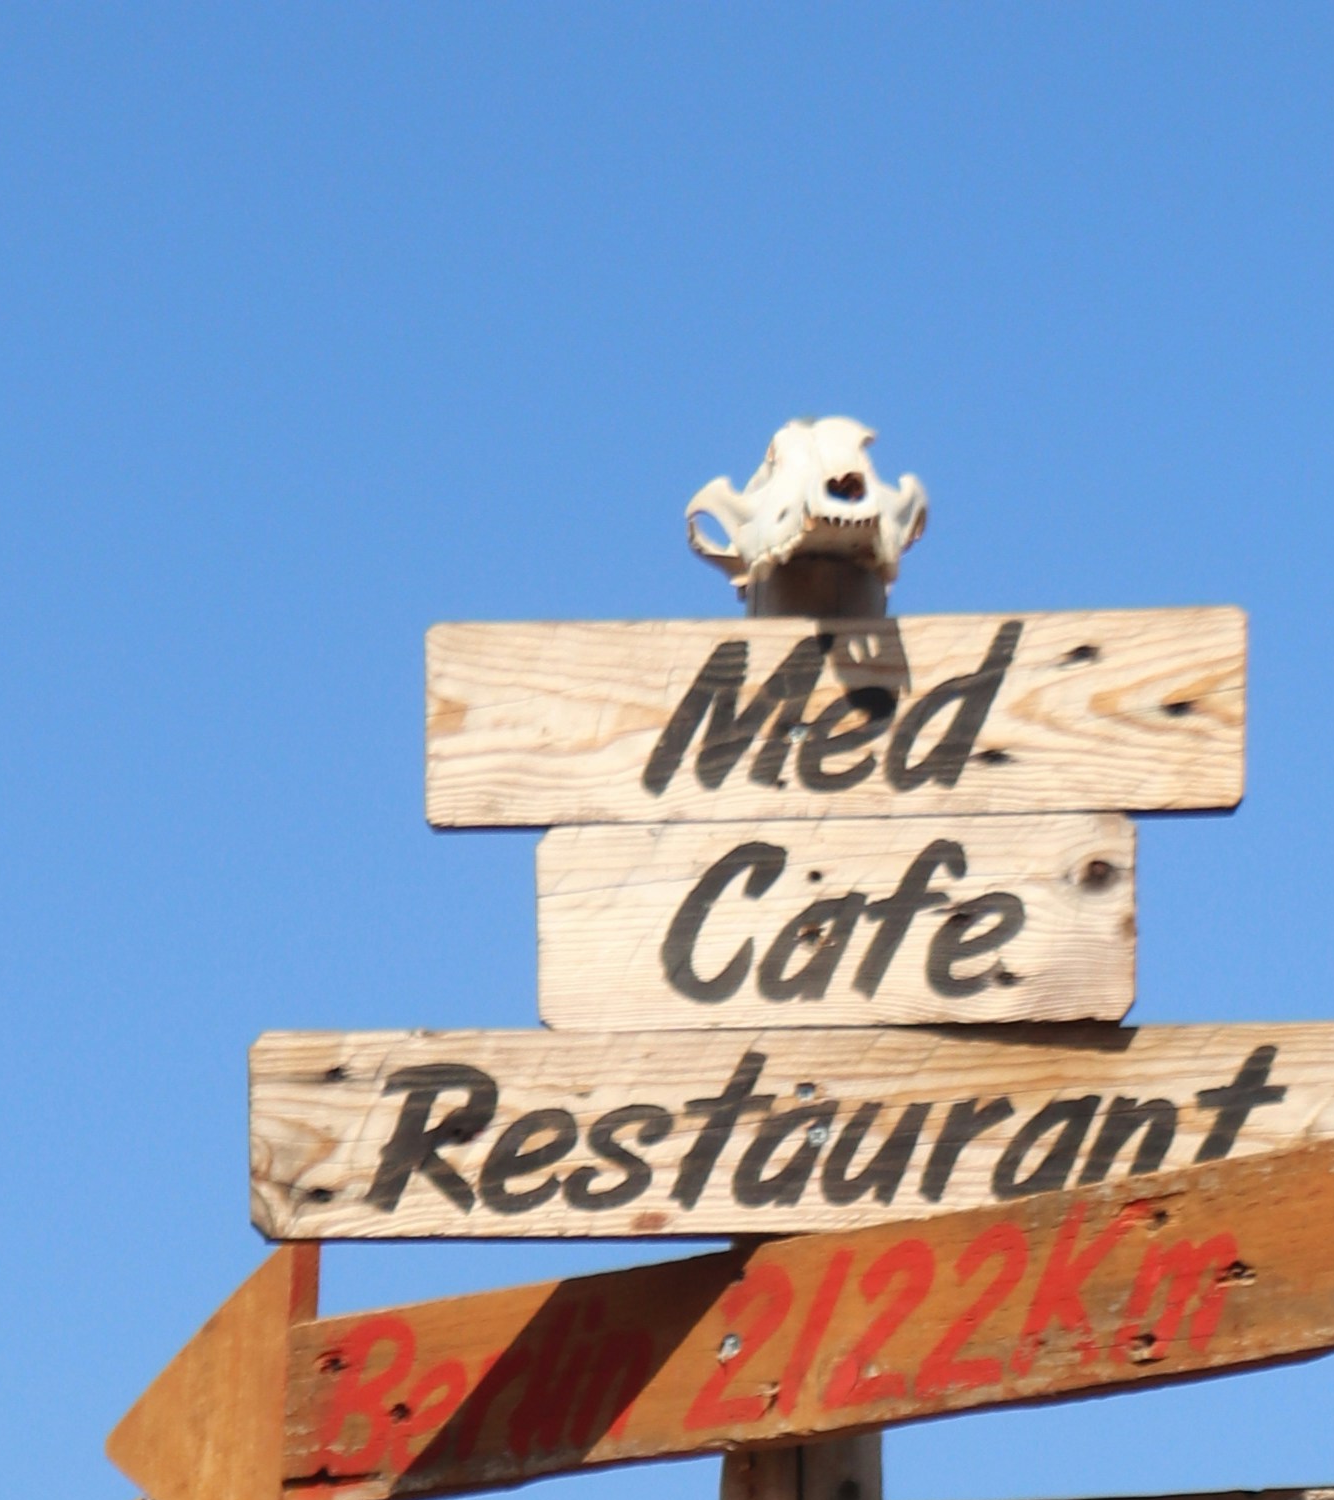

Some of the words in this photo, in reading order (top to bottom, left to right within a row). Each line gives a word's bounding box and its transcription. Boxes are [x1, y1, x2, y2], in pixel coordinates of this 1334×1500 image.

[640, 620, 1024, 797] Med
[661, 838, 1027, 1005] Cafe
[363, 1045, 1289, 1215] Restaurant
[311, 1296, 659, 1478] Berlin
